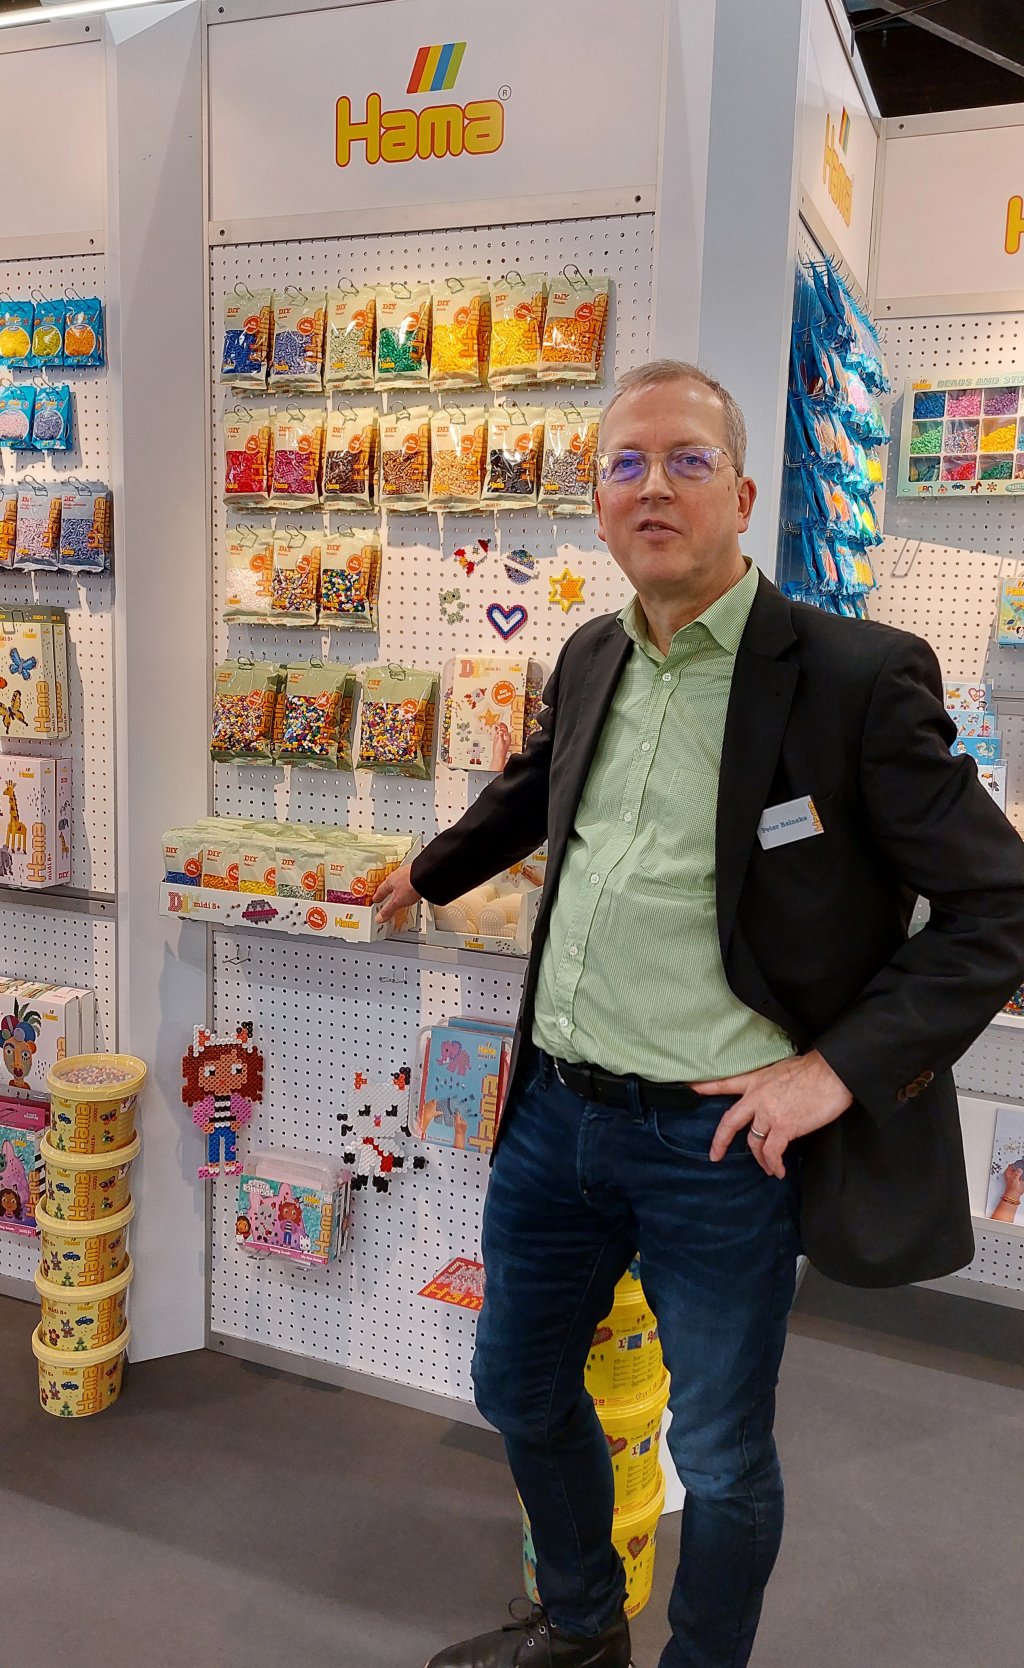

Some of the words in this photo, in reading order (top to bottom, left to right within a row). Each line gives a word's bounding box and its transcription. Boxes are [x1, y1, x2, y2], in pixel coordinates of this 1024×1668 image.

[335, 92, 505, 168] Hama
[823, 113, 852, 228] Hama
[460, 295, 481, 358] Hama
[936, 378, 973, 389] BEADS
[976, 377, 1000, 386] AND
[86, 496, 106, 550] Hama
[33, 680, 51, 733] Hama
[761, 824, 780, 833] Peter
[808, 800, 824, 833] Hama
[26, 821, 47, 882] Hama
[165, 846, 179, 854] DIY
[207, 849, 223, 858] DIY
[244, 855, 259, 863] DIY
[281, 858, 296, 867] DIY
[329, 864, 345, 872] DIY
[193, 901, 211, 910] midi
[334, 916, 360, 930] Hama
[68, 1102, 91, 1153] Hama
[67, 1171, 91, 1222] Hama
[314, 1203, 334, 1256] Hama
[77, 1237, 101, 1287] Hama
[75, 1366, 99, 1415] Hama
